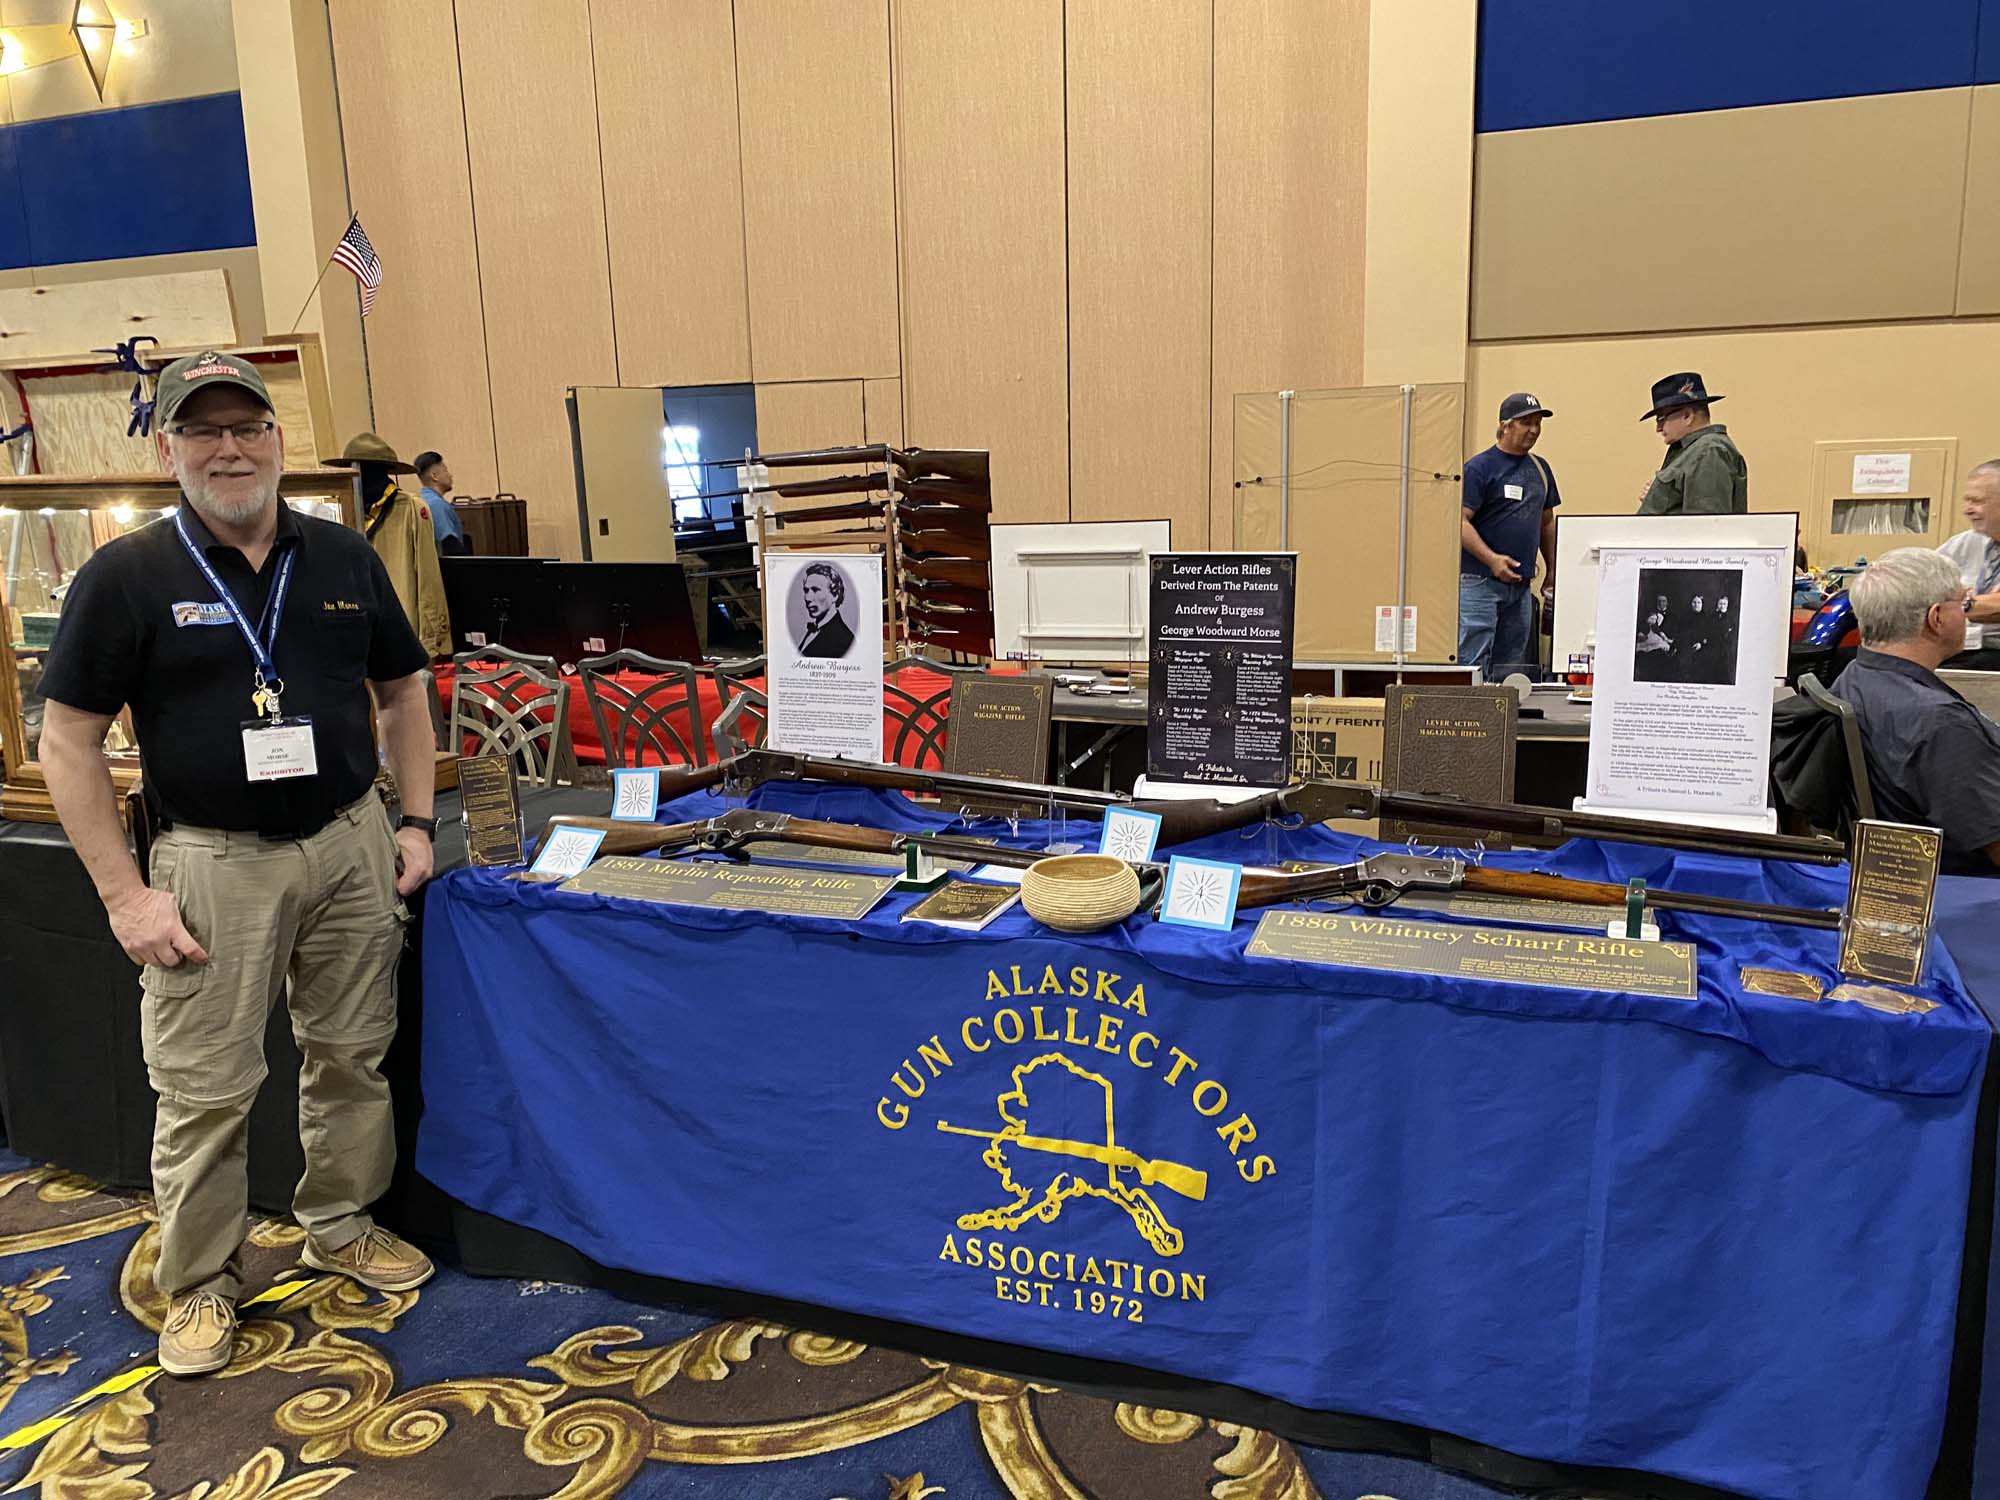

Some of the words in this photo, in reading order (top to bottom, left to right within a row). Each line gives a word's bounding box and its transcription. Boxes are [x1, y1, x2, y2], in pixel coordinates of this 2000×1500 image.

[182, 364, 240, 381] WINCHESTER
[1172, 564, 1202, 575] Lever
[1204, 564, 1238, 575] Action
[1242, 564, 1272, 576] Rifles
[1160, 580, 1196, 590] Derived
[1198, 581, 1221, 590] From
[1223, 582, 1241, 590] The
[1243, 582, 1278, 591] Patents
[199, 604, 228, 613] ALASK
[1175, 604, 1218, 615] Andrew
[1221, 604, 1264, 618] Burgess
[1160, 625, 1194, 637] George
[1196, 626, 1247, 636] Woodward
[1250, 627, 1280, 637] Morse
[792, 660, 824, 670] Andrew
[826, 661, 862, 674] Burgess
[1335, 718, 1385, 727] FRENT
[1419, 728, 1457, 737] MAGAZINE
[1460, 729, 1487, 737] RIFLES
[260, 767, 304, 776] EXHIBITOR
[1124, 834, 1133, 848] 2
[604, 860, 647, 871] 1881
[648, 863, 708, 878] Marlin
[713, 870, 808, 889] Repeating
[811, 878, 856, 890] Rifle
[1194, 885, 1204, 899] 4
[1278, 914, 1338, 930] 1886
[1350, 920, 1463, 945] Whitney
[1472, 932, 1569, 952] Scharf
[1576, 941, 1645, 958] Rifle
[985, 964, 1148, 1016] ALASKA
[876, 1034, 954, 1130] GUN
[961, 1006, 1277, 1183] COLLECTORS
[939, 1234, 1206, 1302] ASSOCIATION
[996, 1276, 1060, 1308] EST.
[1074, 1288, 1144, 1323] 1972
